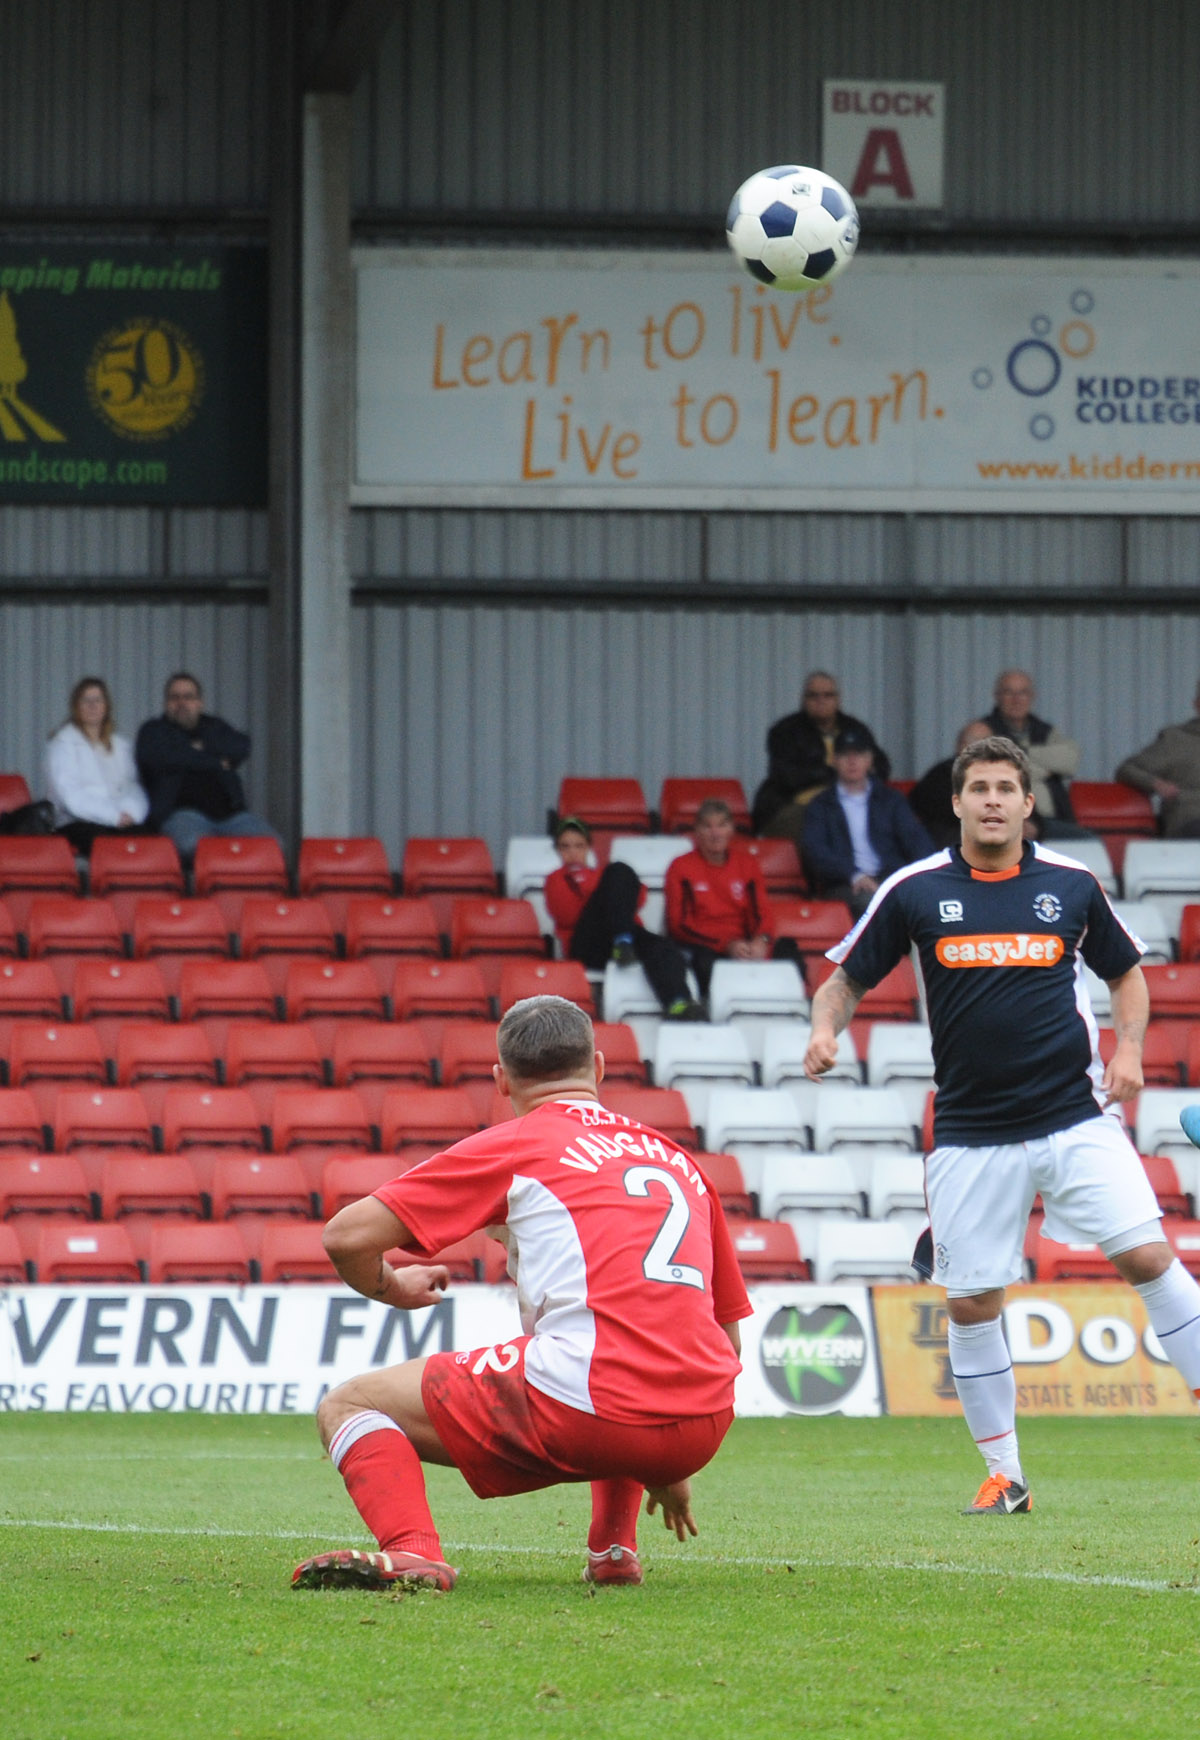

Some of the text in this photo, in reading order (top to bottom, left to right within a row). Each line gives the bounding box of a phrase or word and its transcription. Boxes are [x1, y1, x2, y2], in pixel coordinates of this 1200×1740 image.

[831, 90, 932, 116] BLOCK
[852, 127, 914, 200] A
[86, 260, 221, 290] Materials
[99, 327, 182, 407] 50
[432, 282, 843, 390] Learn to live.
[521, 368, 946, 481] Live to learn.
[942, 934, 1057, 966] easyJet
[559, 1132, 708, 1196] VAUGHAN
[623, 1165, 707, 1293] 2
[319, 1297, 455, 1366] FM
[761, 1337, 864, 1359] WYVERN
[65, 1383, 299, 1412] FAVOURITE
[1083, 1383, 1158, 1407] AGENTS
